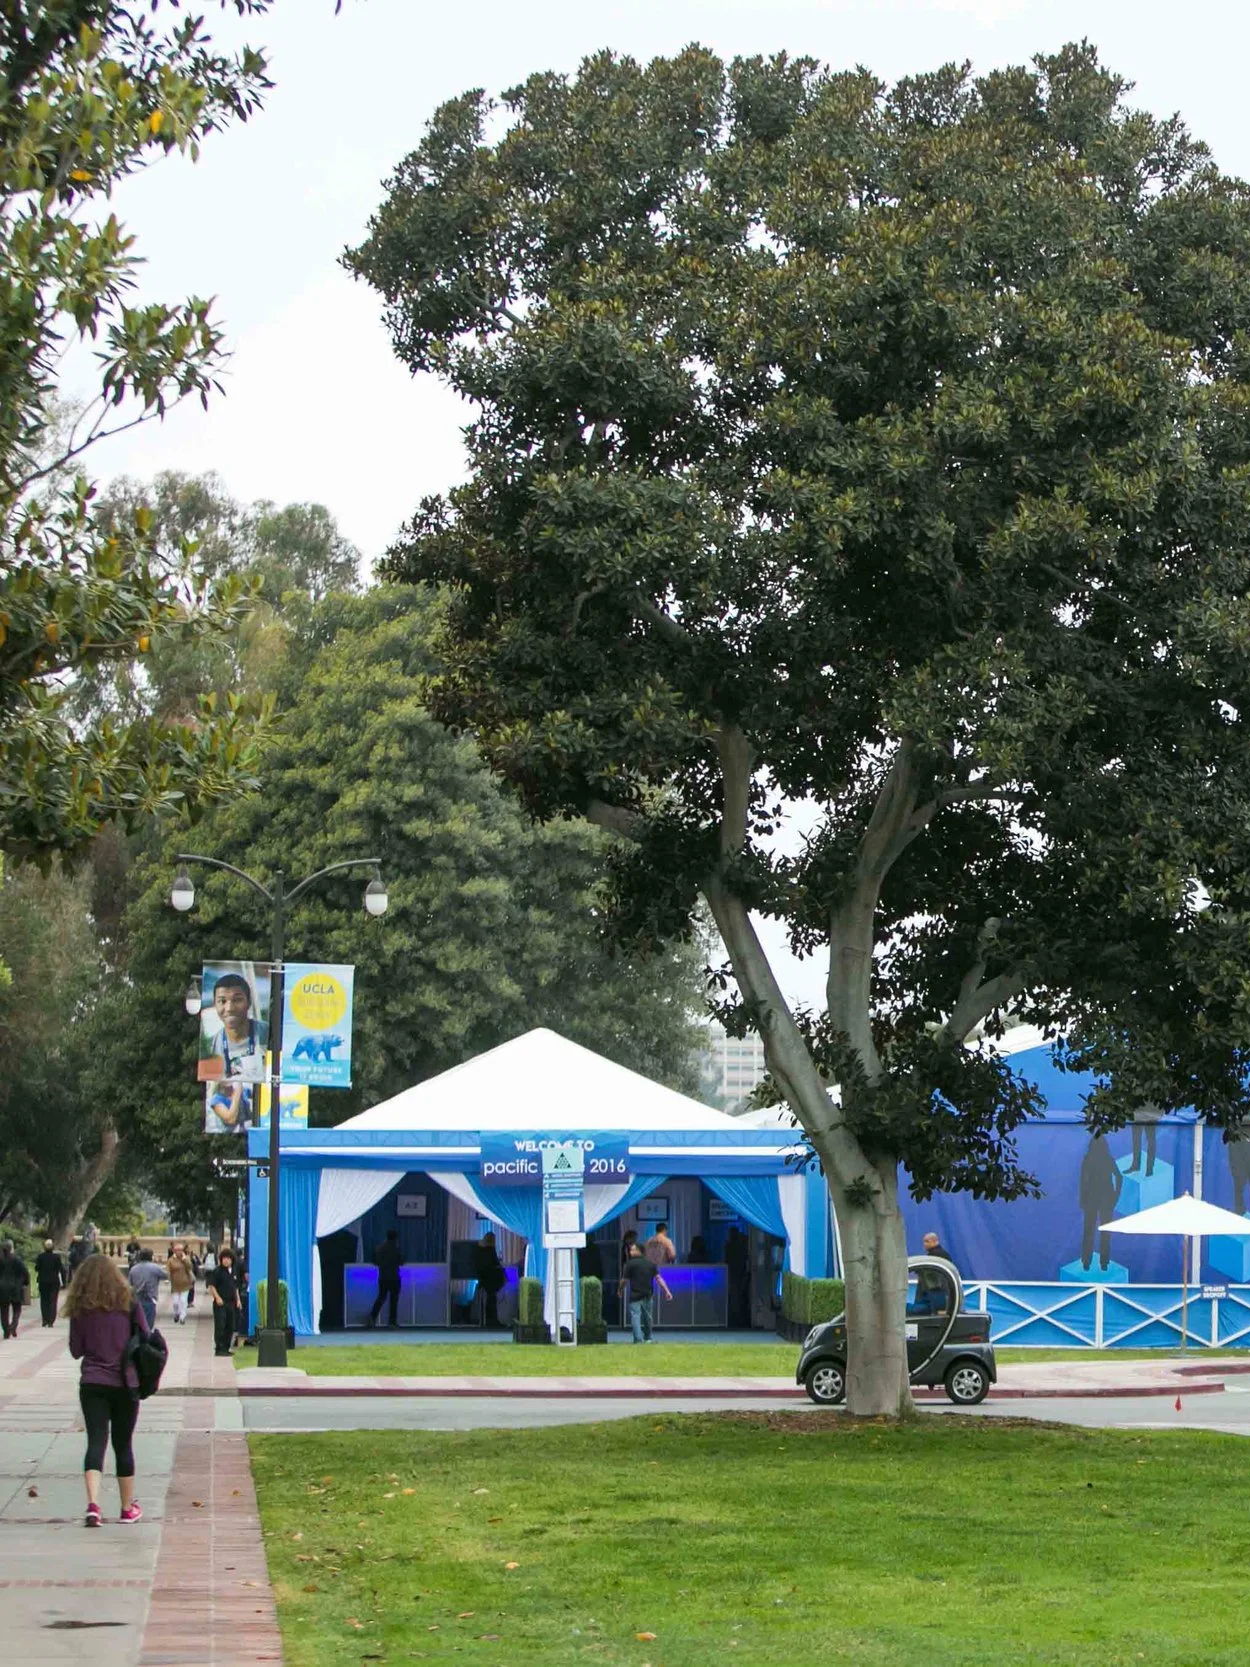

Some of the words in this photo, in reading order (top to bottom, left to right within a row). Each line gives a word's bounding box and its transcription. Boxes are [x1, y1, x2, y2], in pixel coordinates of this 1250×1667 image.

[303, 983, 335, 994] UCLA
[514, 1140, 576, 1152] WELCOME
[577, 1140, 595, 1152] TO
[484, 1159, 538, 1176] pacific
[590, 1159, 626, 1173] 2016
